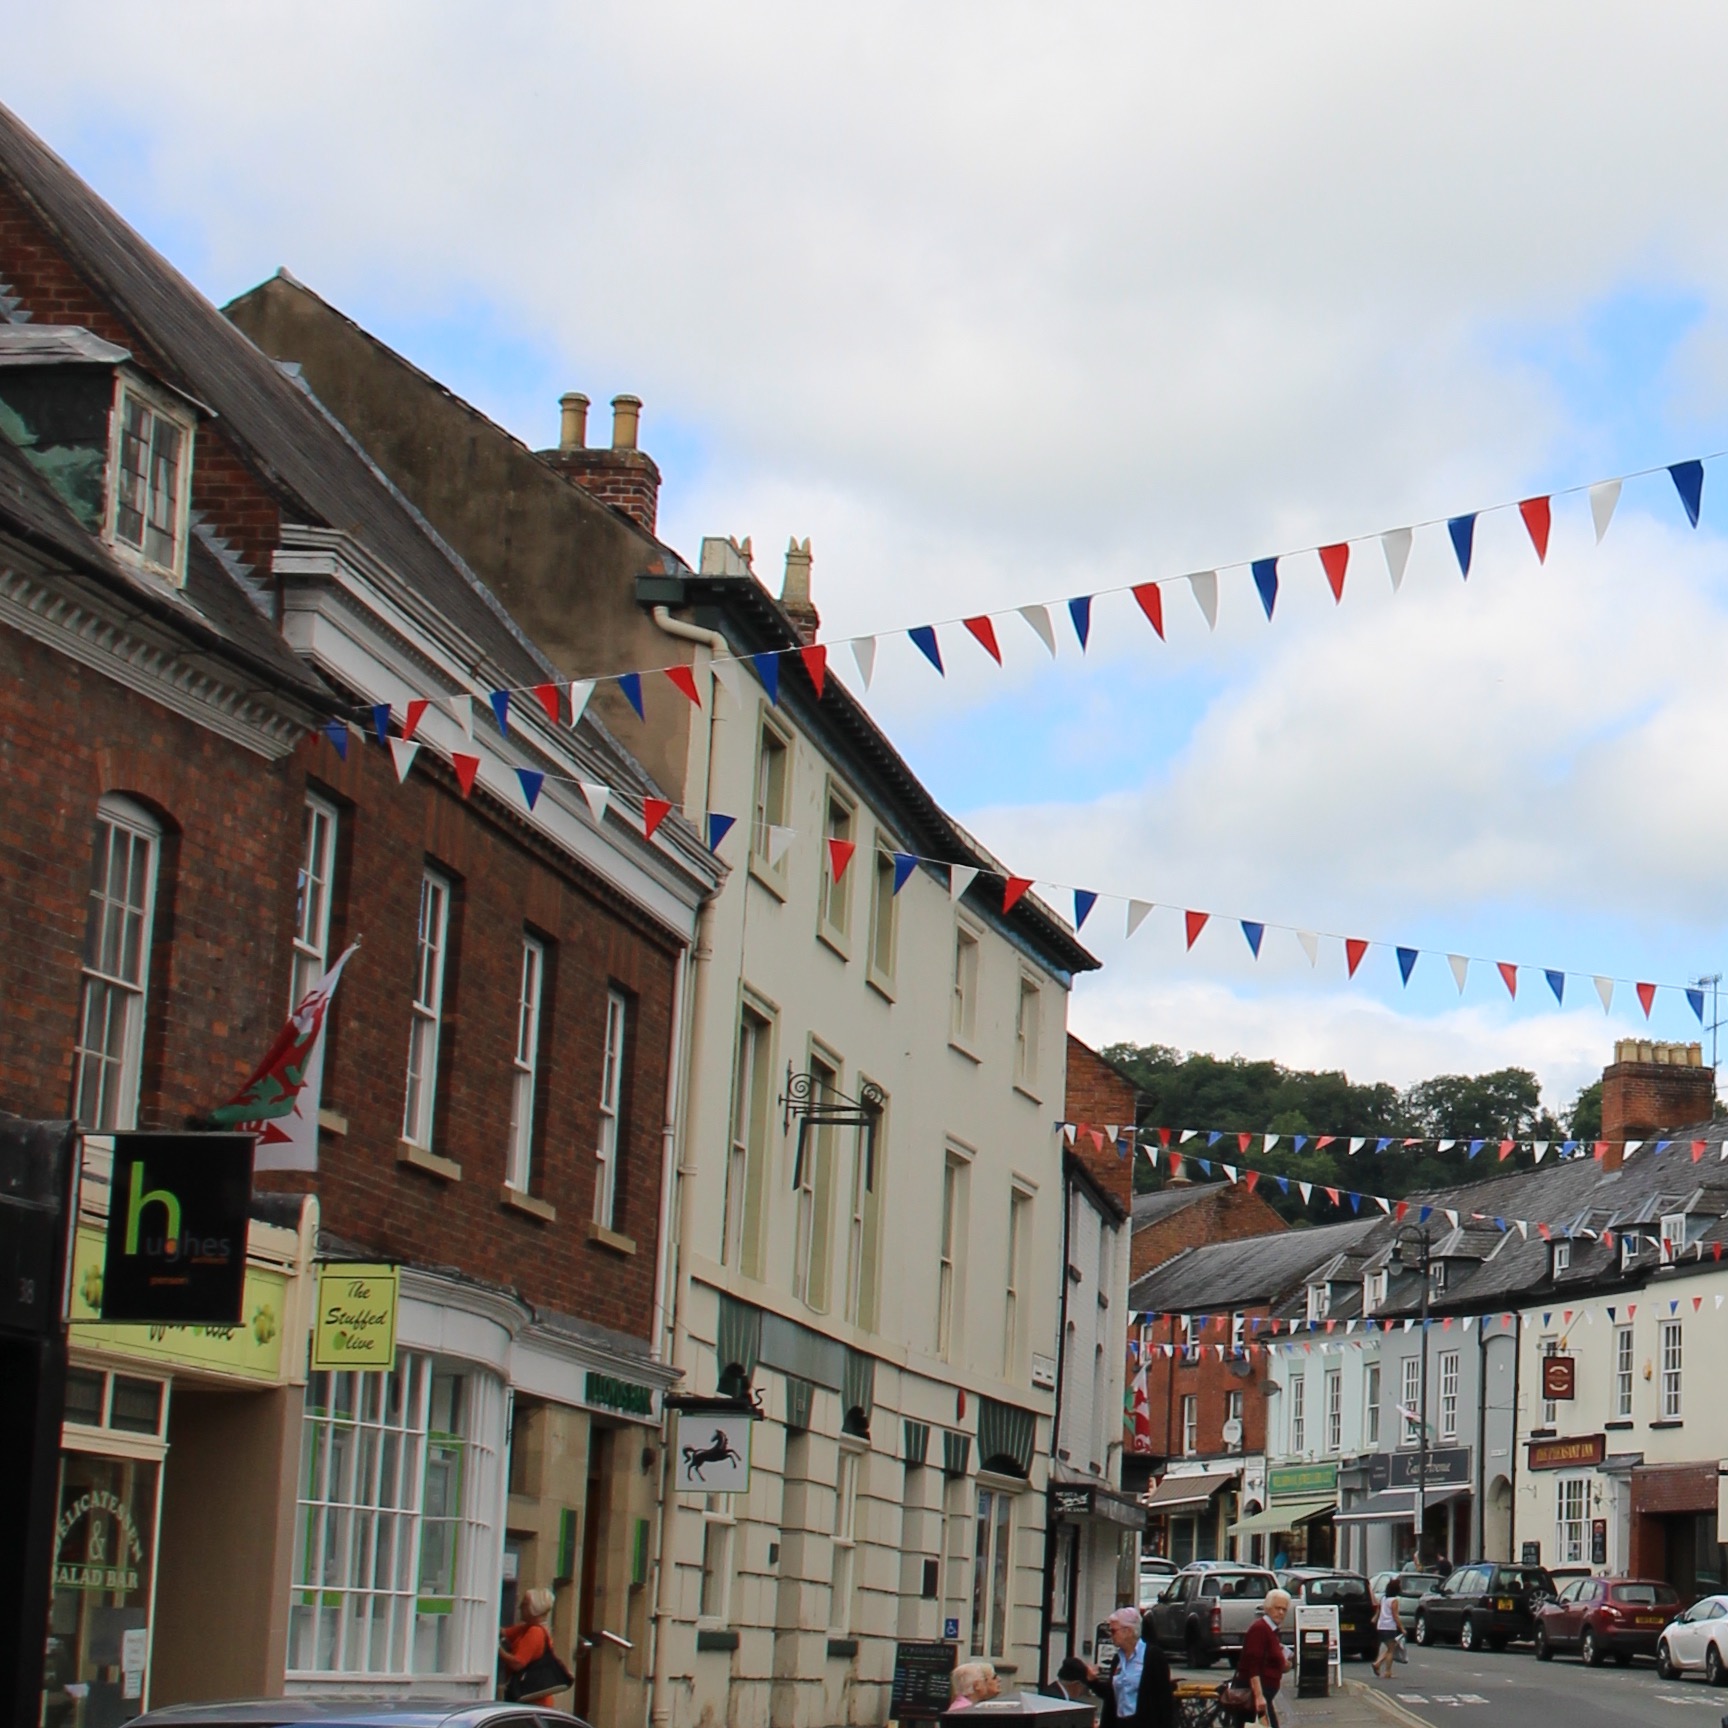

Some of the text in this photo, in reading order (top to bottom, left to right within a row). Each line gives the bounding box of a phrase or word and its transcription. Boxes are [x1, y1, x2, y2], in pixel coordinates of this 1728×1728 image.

[347, 1280, 371, 1299] The
[325, 1307, 389, 1331] Stuffed
[105, 1570, 139, 1589] BAR
